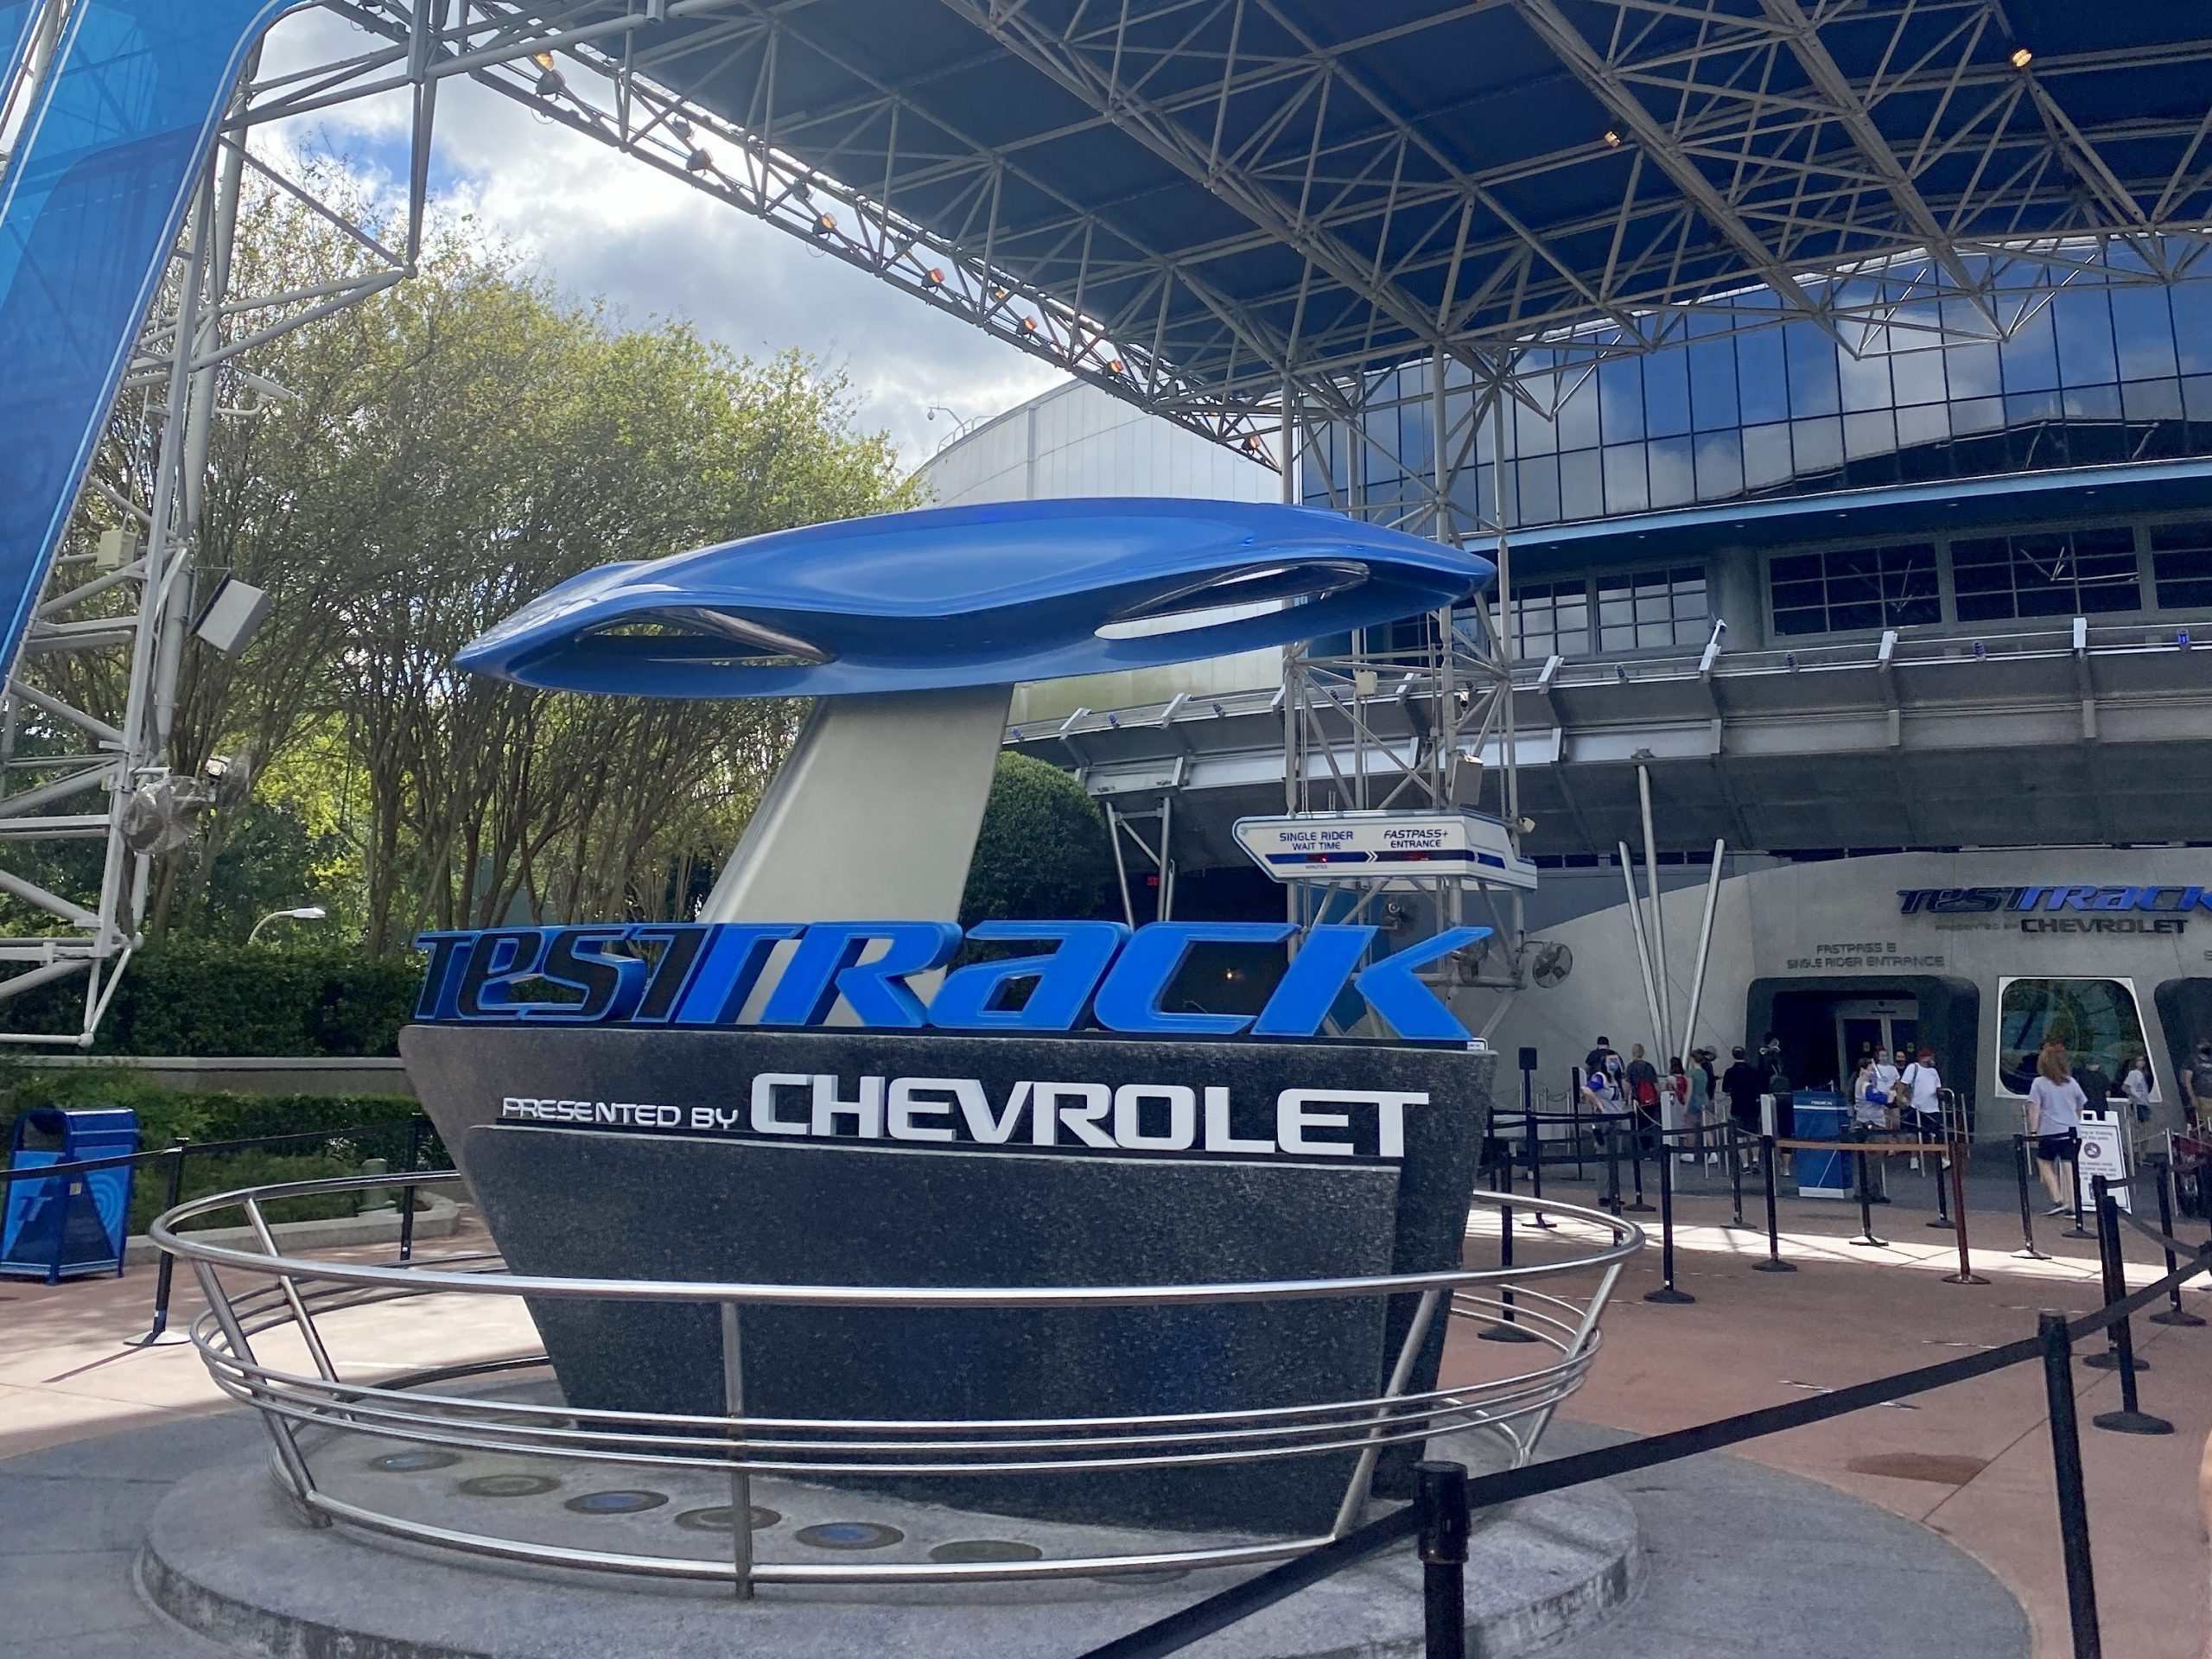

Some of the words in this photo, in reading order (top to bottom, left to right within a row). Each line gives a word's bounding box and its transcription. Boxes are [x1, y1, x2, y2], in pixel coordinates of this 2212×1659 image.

[1279, 831, 1317, 842] SINGLE
[1320, 830, 1354, 841] RIDER
[1383, 830, 1450, 840] FASTPASS+
[1292, 842, 1316, 851] WAIT
[1318, 842, 1341, 850] TIME
[1390, 839, 1442, 849] ENTRANCE
[2021, 918, 2190, 934] CHEVROLET
[1816, 942, 1883, 955] FASTPASS
[1787, 958, 1823, 969] SINGLE
[1825, 957, 1863, 968] RIDER
[1866, 956, 1945, 967] ENTRANCE
[502, 1096, 682, 1128] PRESENTED
[690, 1107, 740, 1130] BY
[751, 1072, 1430, 1159] CHEVROLET
